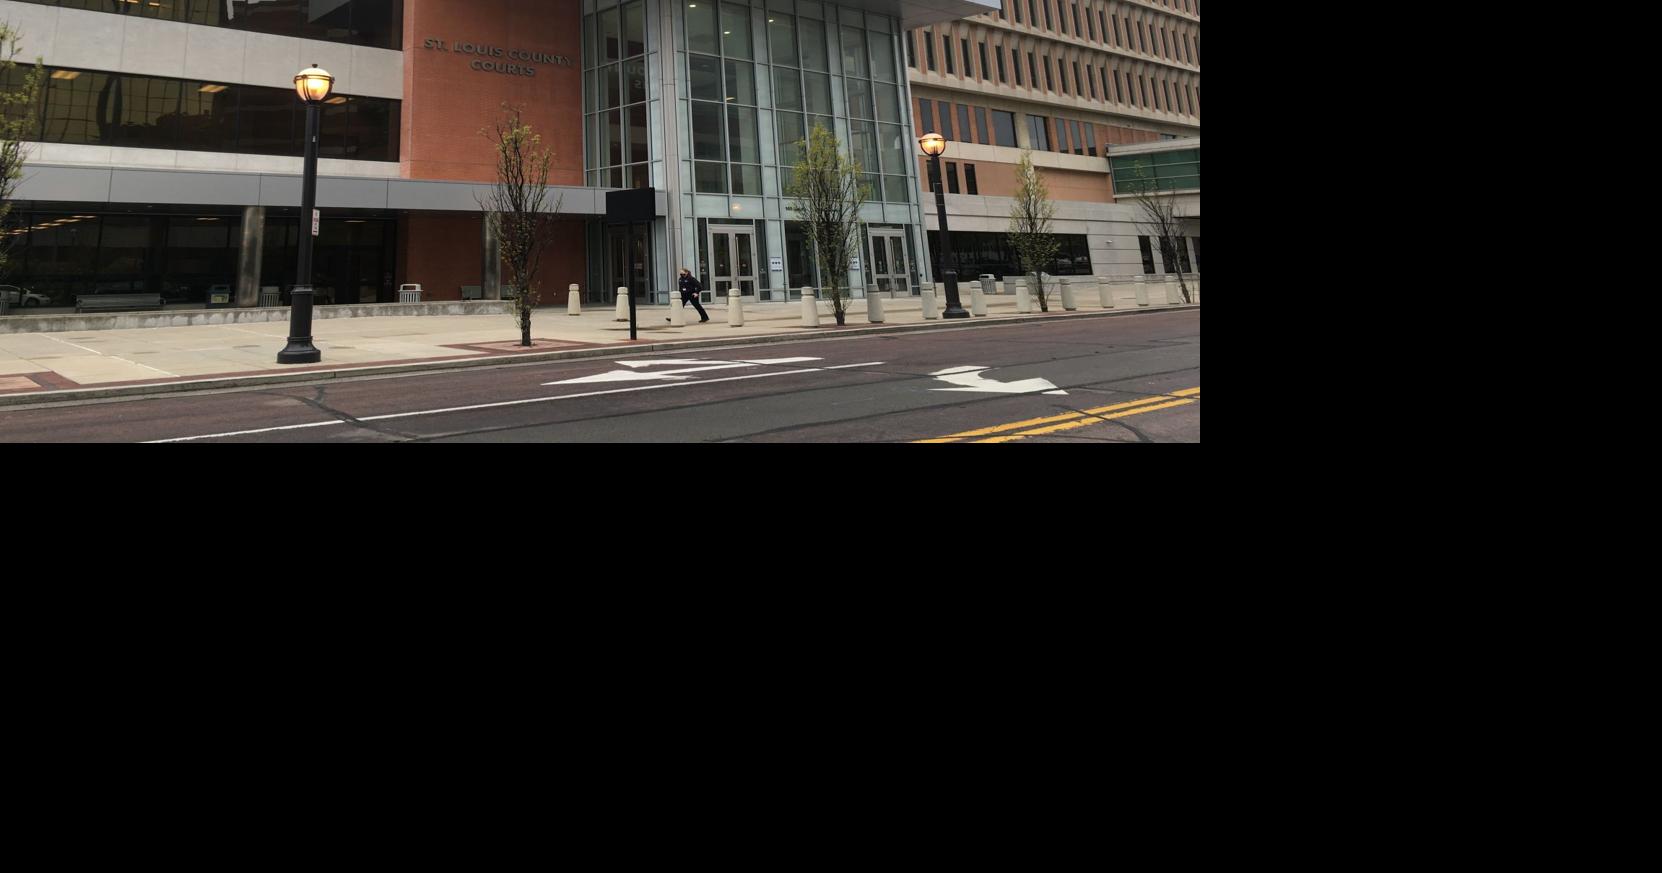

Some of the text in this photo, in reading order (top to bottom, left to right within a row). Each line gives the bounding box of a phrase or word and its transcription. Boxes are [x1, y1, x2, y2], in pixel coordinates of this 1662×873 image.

[424, 37, 573, 67] ST. LOUIS COUNTY
[471, 59, 536, 77] COURTS
